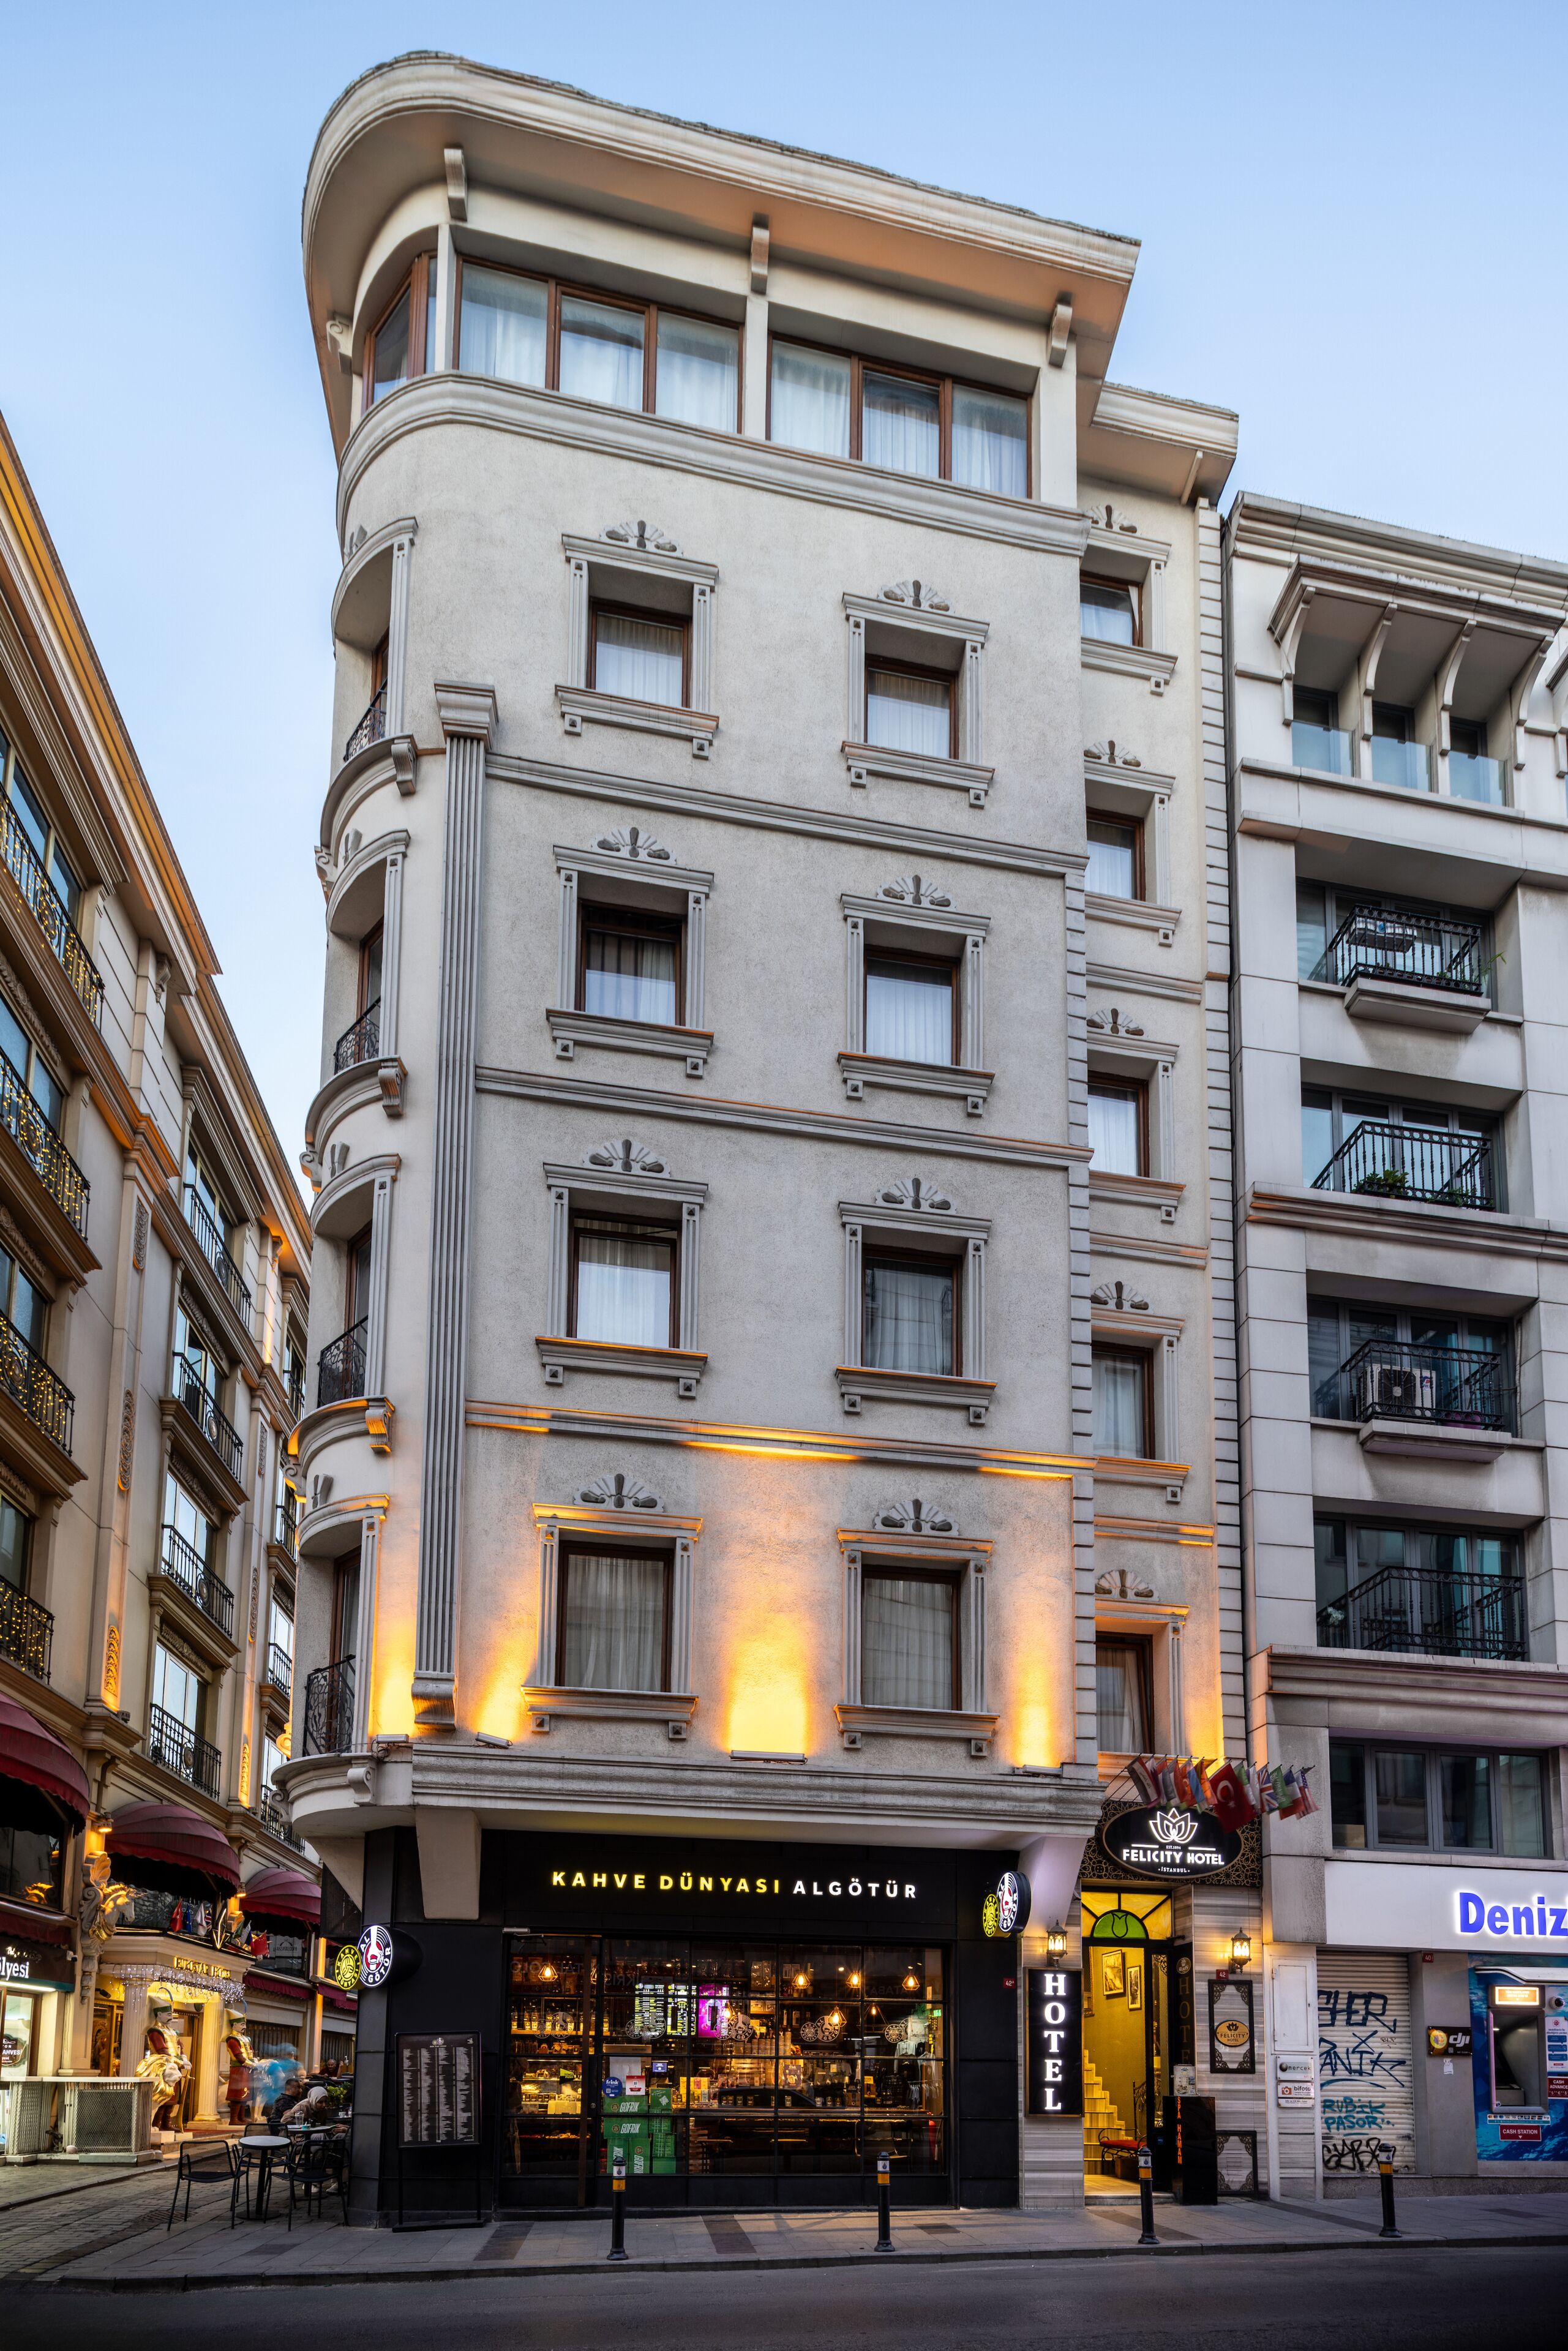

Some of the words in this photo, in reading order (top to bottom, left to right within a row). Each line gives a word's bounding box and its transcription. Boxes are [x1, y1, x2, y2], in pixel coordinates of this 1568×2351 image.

[1123, 1849, 1182, 1864] FELICITY
[1187, 1853, 1225, 1865] HOTEL
[552, 1872, 645, 1889] KAHVE
[659, 1872, 779, 1894] DÜNYASI
[793, 1878, 916, 1899] ALGÖTÜR
[1460, 1892, 1568, 1937] Deniz
[360, 1936, 370, 1952] AL
[0, 1956, 29, 1981] lyesi
[337, 1948, 358, 1967] KAHVE
[368, 1947, 391, 1983] GÖTÜR
[337, 1969, 359, 1987] DÜNYASI
[1179, 1977, 1190, 2064] HOTE
[1044, 1973, 1066, 2110] HOTEL
[1324, 2114, 1382, 2133] PASOR
